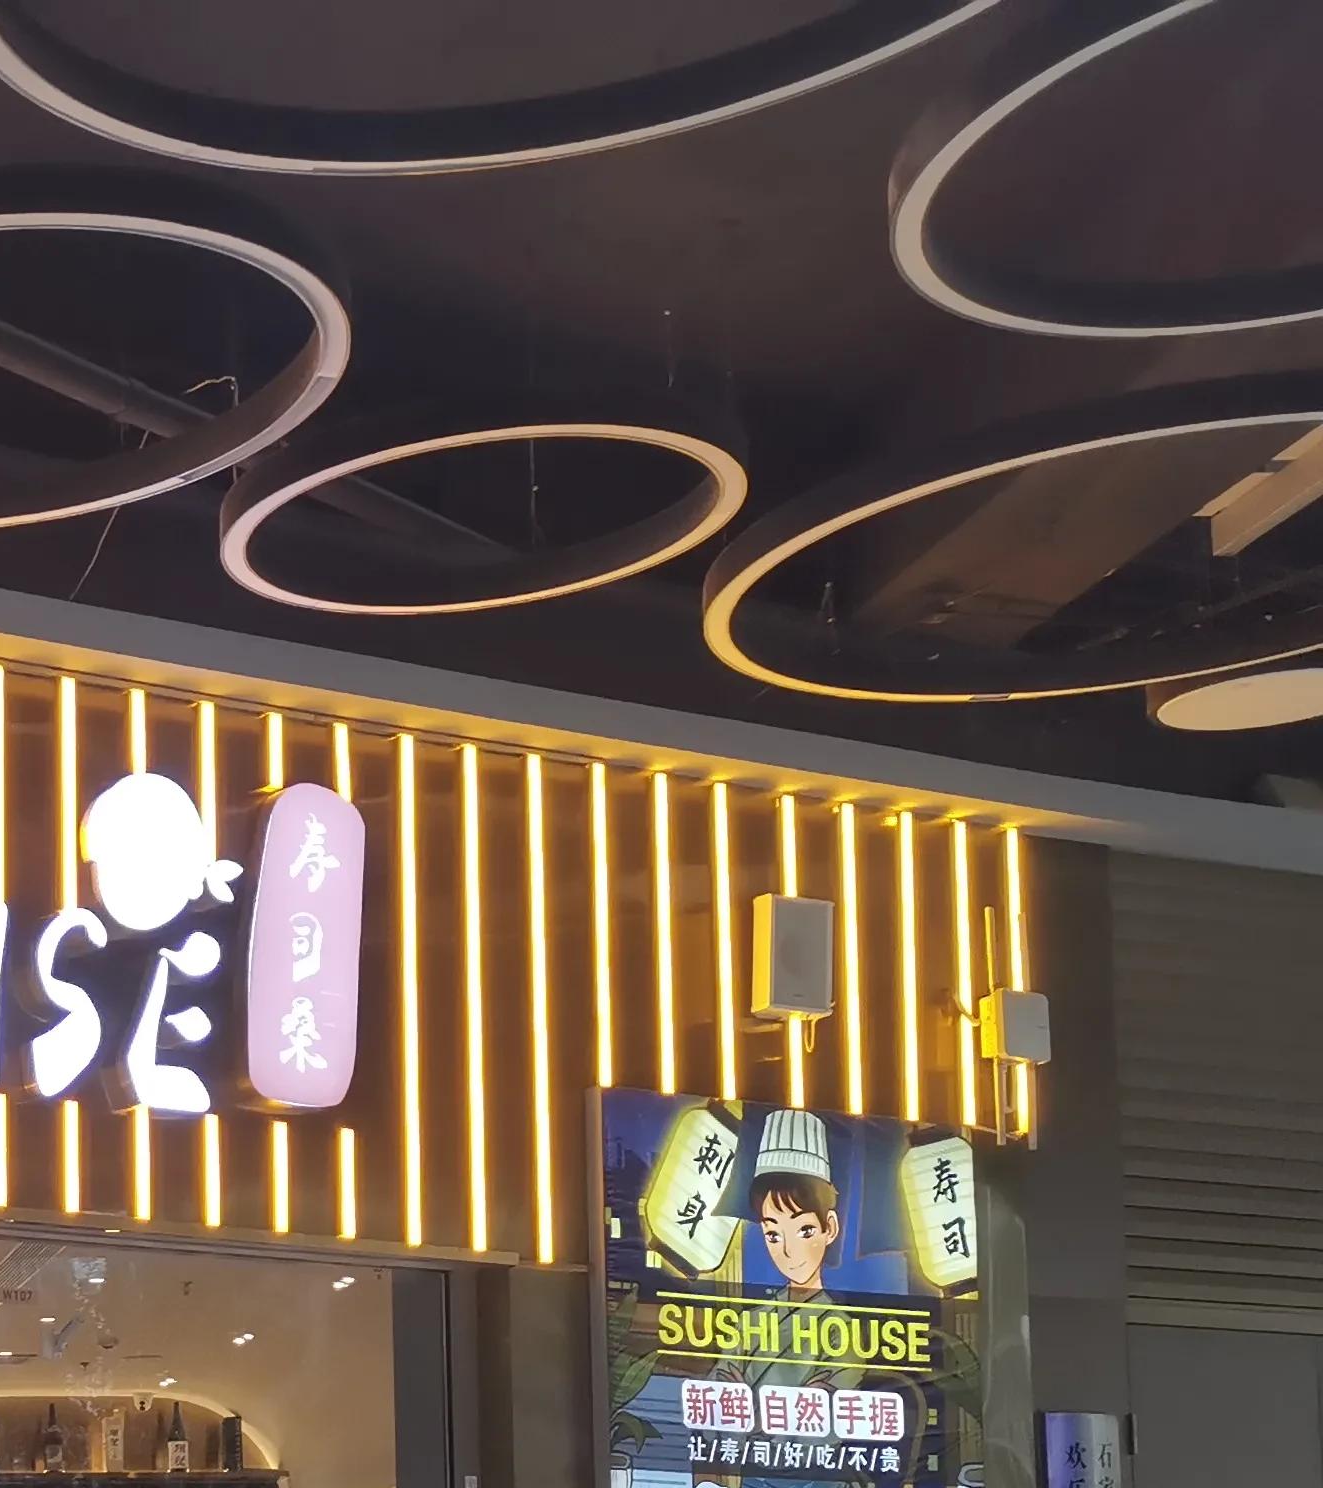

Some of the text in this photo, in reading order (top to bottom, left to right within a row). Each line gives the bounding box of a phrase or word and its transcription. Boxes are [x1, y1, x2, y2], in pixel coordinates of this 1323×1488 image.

[279, 811, 342, 1074] 寿司桑
[675, 1132, 735, 1240] 刺身
[932, 1157, 972, 1259] 寿司
[656, 1302, 932, 1365] SUSHI HOUSE
[686, 1383, 901, 1438] 新鲜 自然 手握
[687, 1438, 901, 1474] 让/寿/司/好/吃/不/贵
